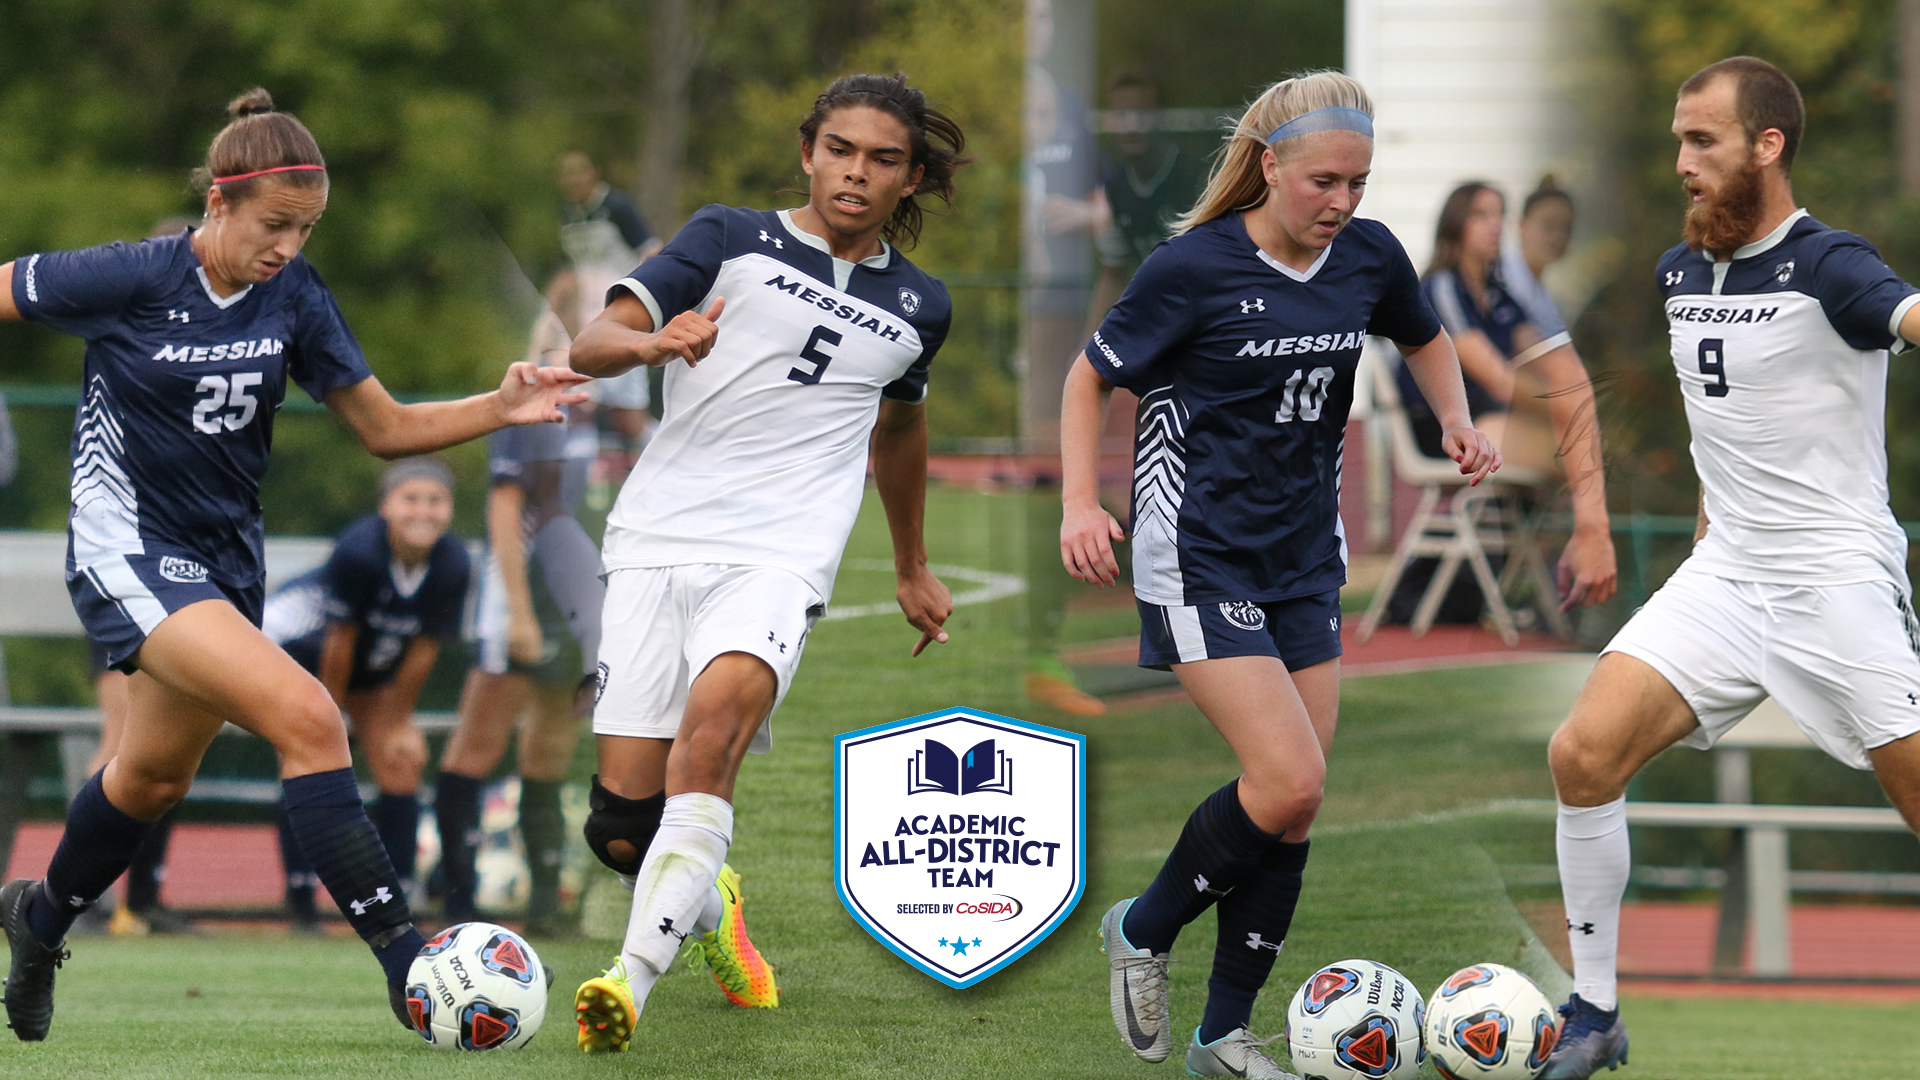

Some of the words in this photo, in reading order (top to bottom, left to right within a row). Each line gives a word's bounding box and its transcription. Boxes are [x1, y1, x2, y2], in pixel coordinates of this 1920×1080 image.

[764, 275, 902, 342] MESSIAH
[152, 338, 284, 362] MESSIAH
[787, 324, 843, 385] 5
[1093, 330, 1124, 368] FALCONS
[1236, 329, 1366, 358] MESSIAH
[1698, 338, 1729, 397] 9
[192, 372, 263, 434] 25
[1274, 366, 1336, 423] 10
[431, 964, 456, 1009] Wilson
[449, 955, 475, 991] NCAA
[1367, 970, 1383, 1006] Wilson
[1391, 978, 1406, 1012] NCAA
